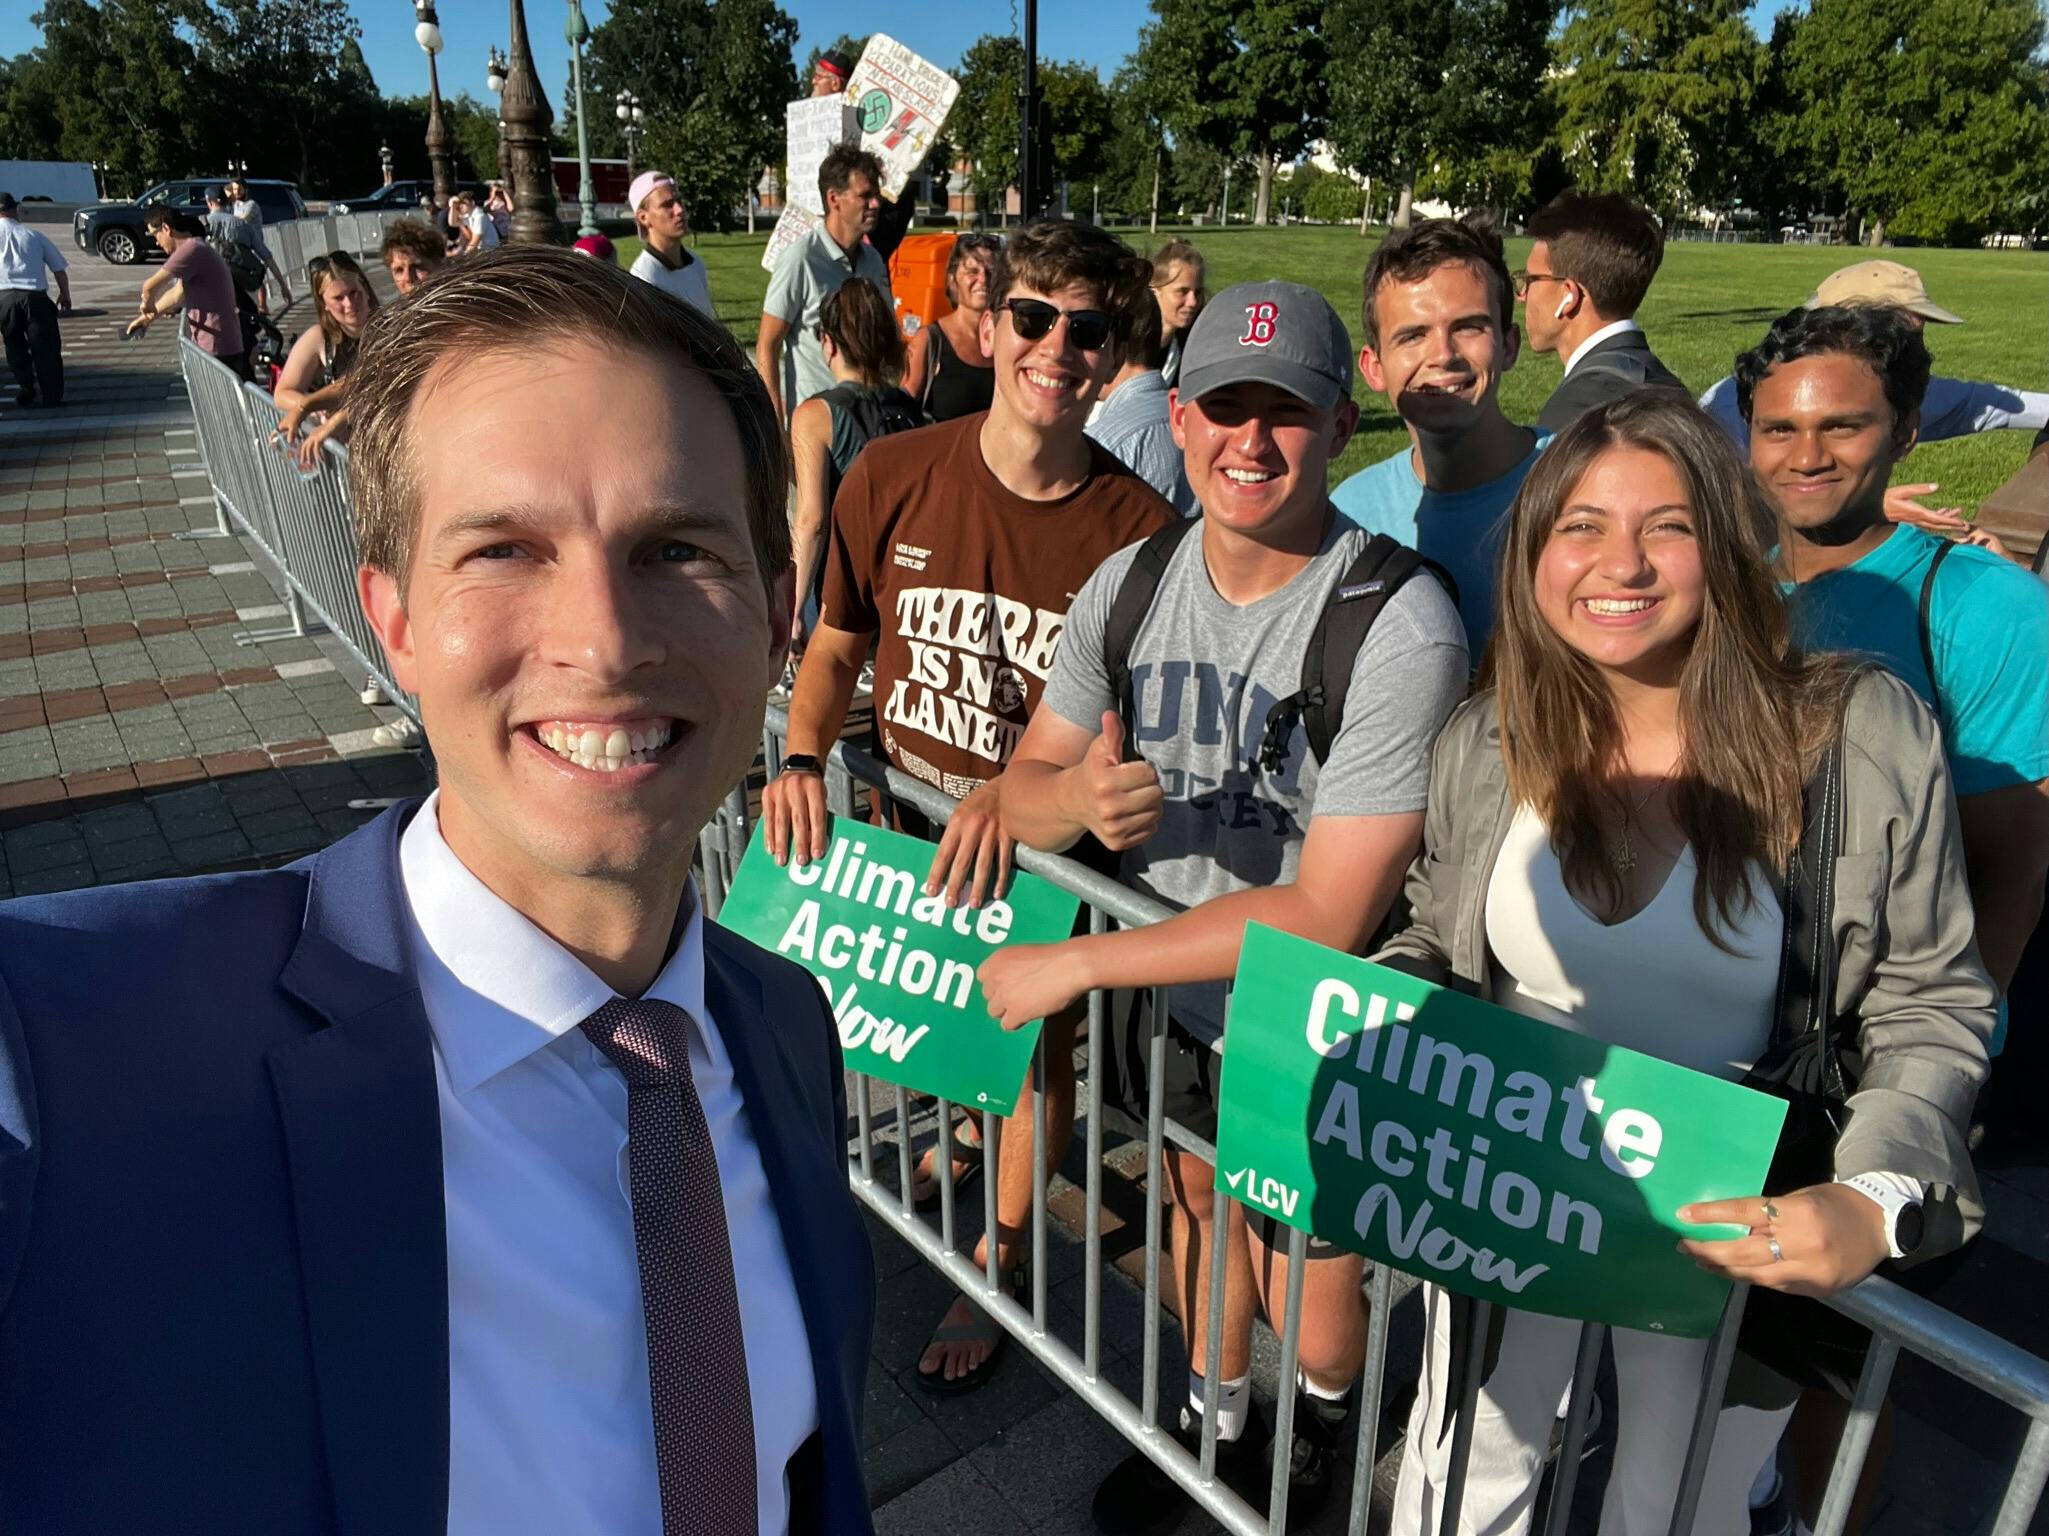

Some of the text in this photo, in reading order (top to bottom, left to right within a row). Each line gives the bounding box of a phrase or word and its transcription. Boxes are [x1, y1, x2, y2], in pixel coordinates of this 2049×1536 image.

[1238, 301, 1280, 347] B
[896, 587, 1067, 682] THERE
[907, 640, 950, 690] IS
[776, 899, 975, 1009] Action
[1305, 978, 1663, 1179] Climate
[1246, 1167, 1300, 1218] LCV
[1313, 1080, 1604, 1255] Action
[1354, 1183, 1550, 1294] Now
